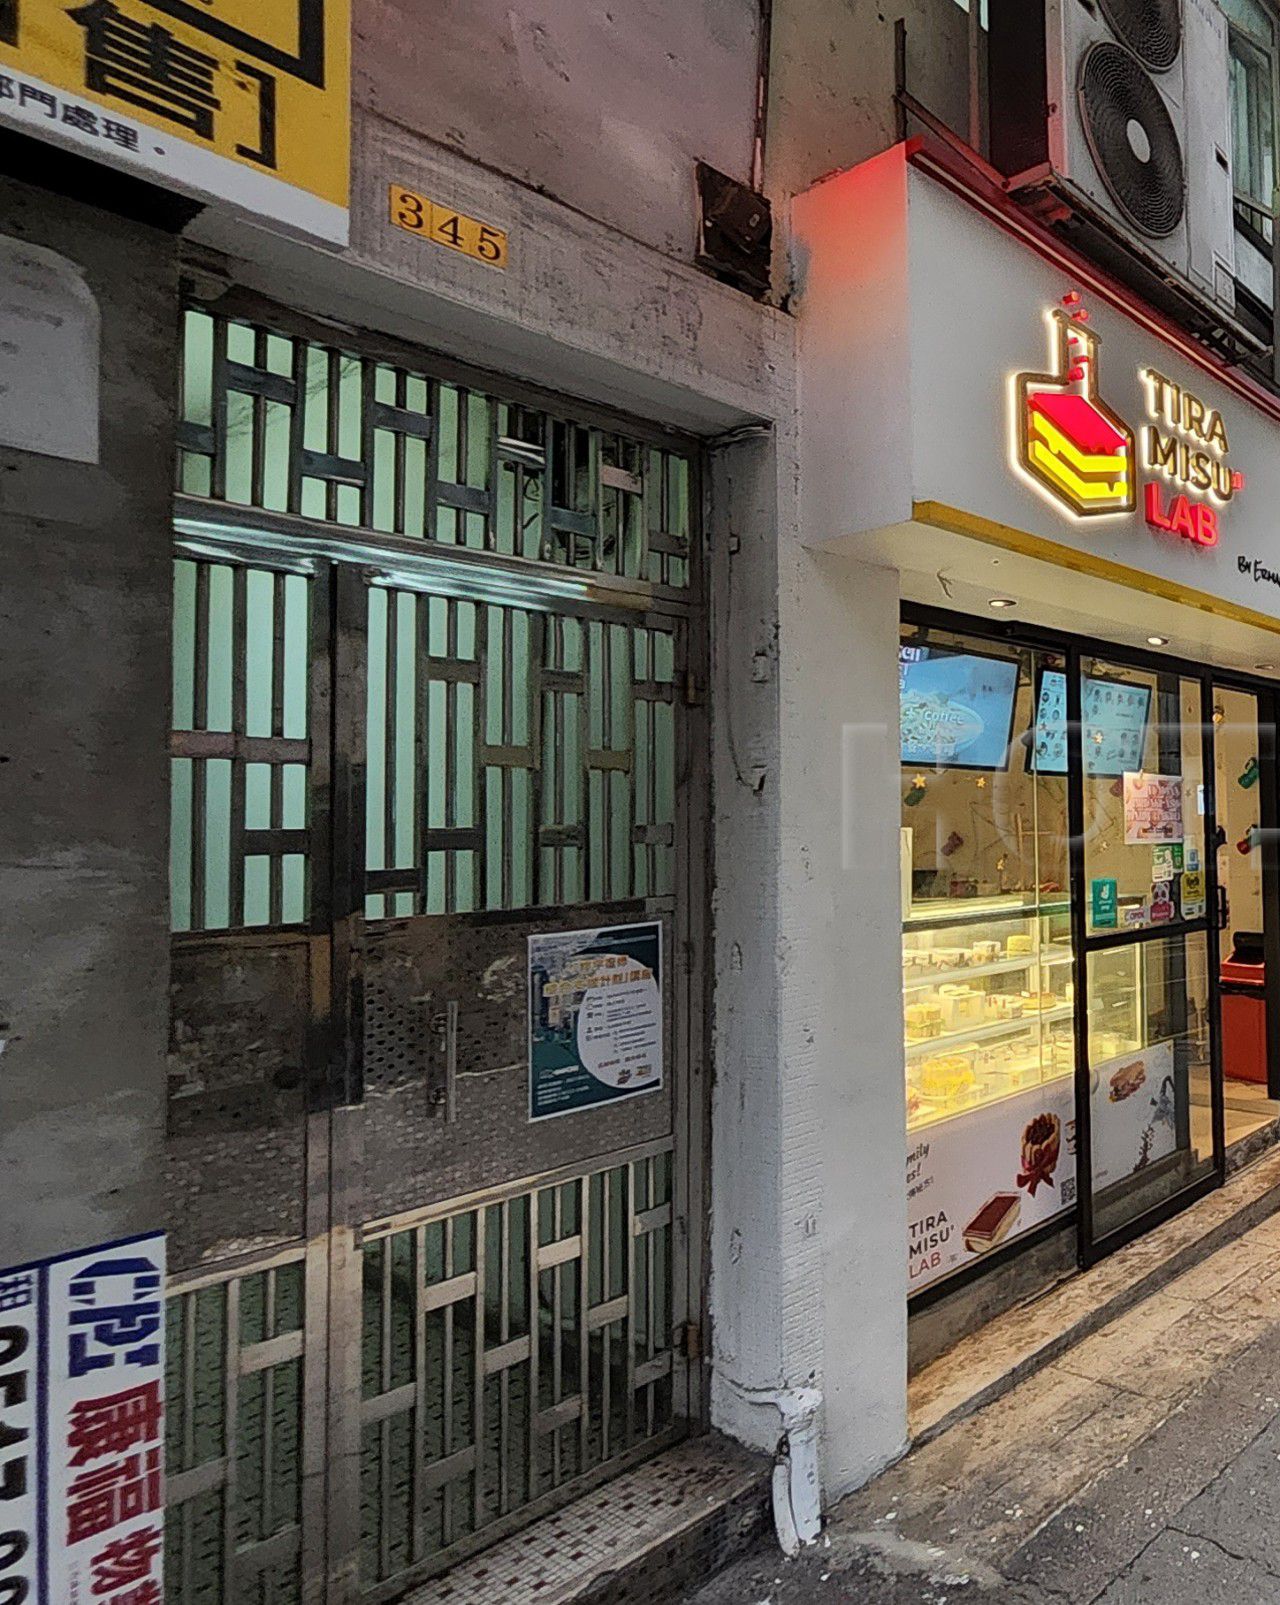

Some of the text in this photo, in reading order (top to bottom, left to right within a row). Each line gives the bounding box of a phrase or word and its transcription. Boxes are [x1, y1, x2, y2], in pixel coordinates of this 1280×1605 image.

[398, 194, 500, 261] 345
[1146, 368, 1229, 453] TIRA
[1144, 481, 1218, 546] LAB
[909, 1211, 947, 1239] TIRA
[909, 1251, 941, 1279] LAB
